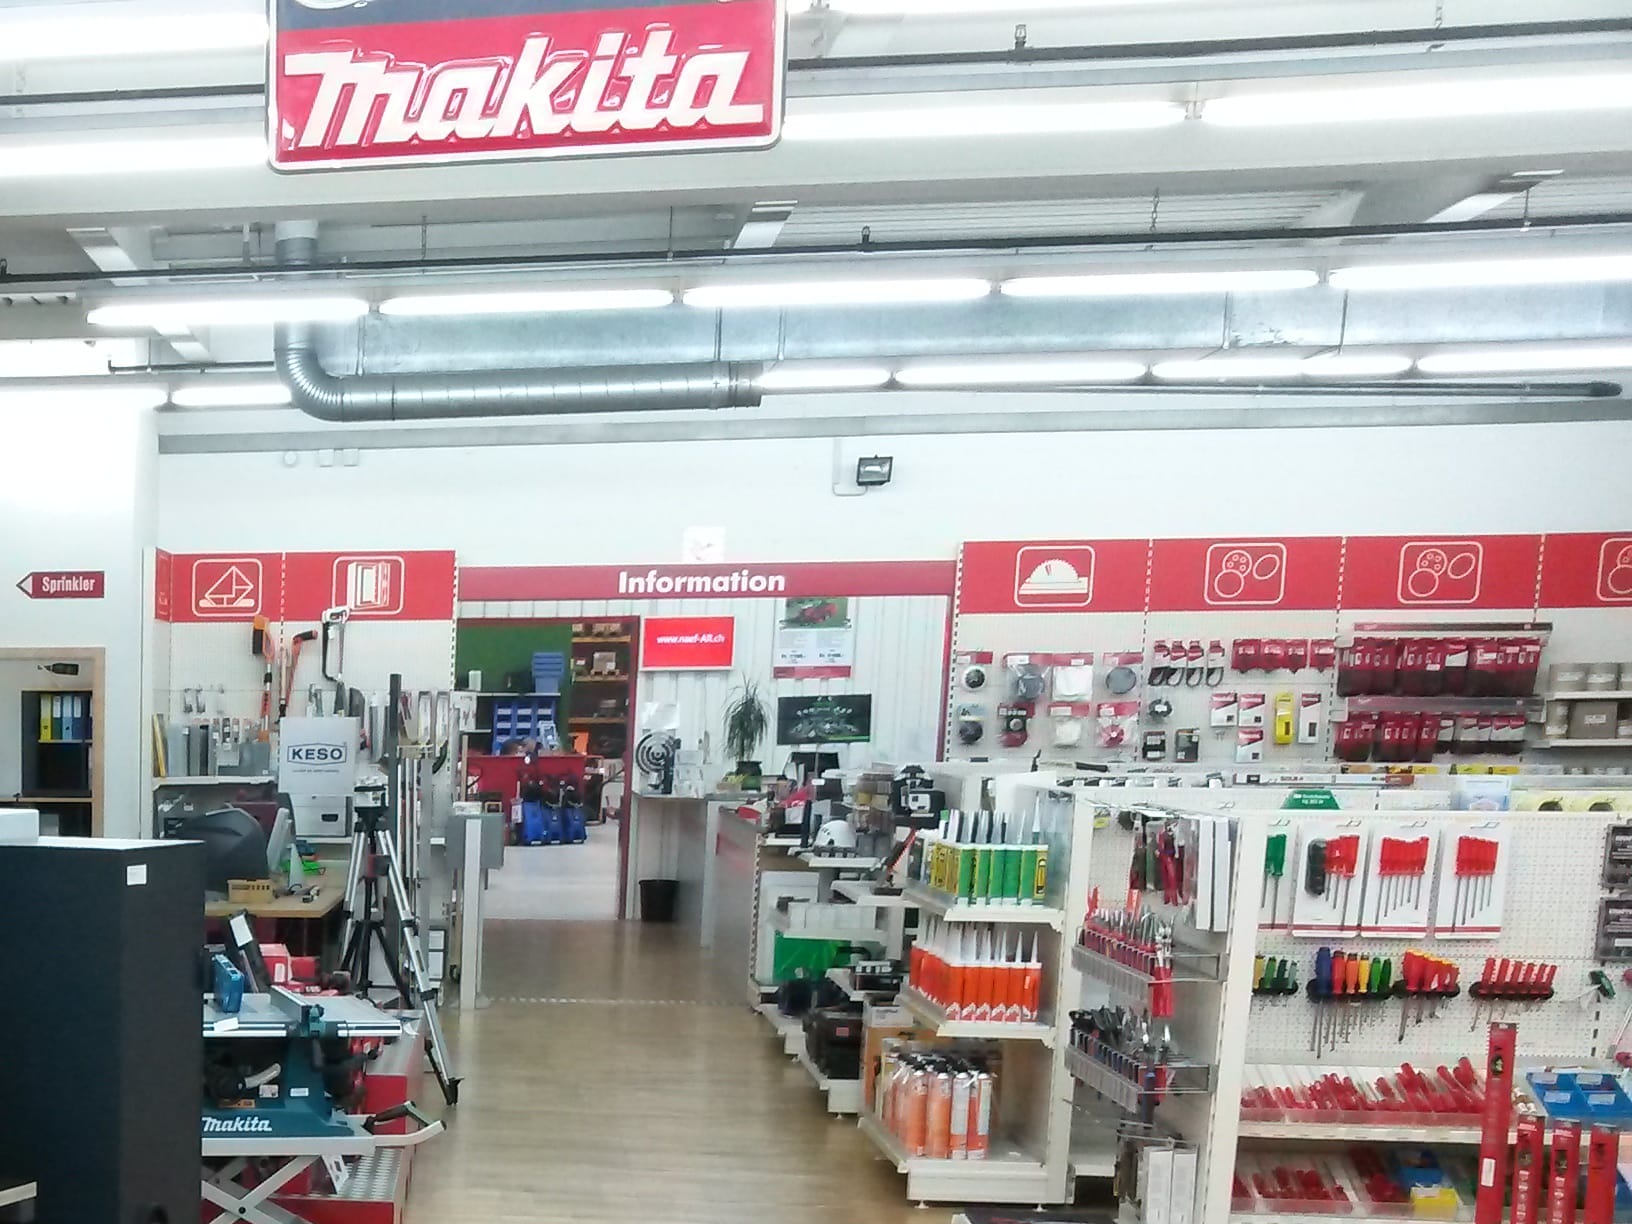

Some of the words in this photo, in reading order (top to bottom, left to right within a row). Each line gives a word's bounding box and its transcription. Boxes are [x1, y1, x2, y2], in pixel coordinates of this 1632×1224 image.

[284, 23, 764, 149] Makita
[41, 575, 96, 594] Sprinkler
[618, 569, 786, 593] Information
[291, 747, 344, 761] KESO
[202, 1116, 272, 1132] Makita
